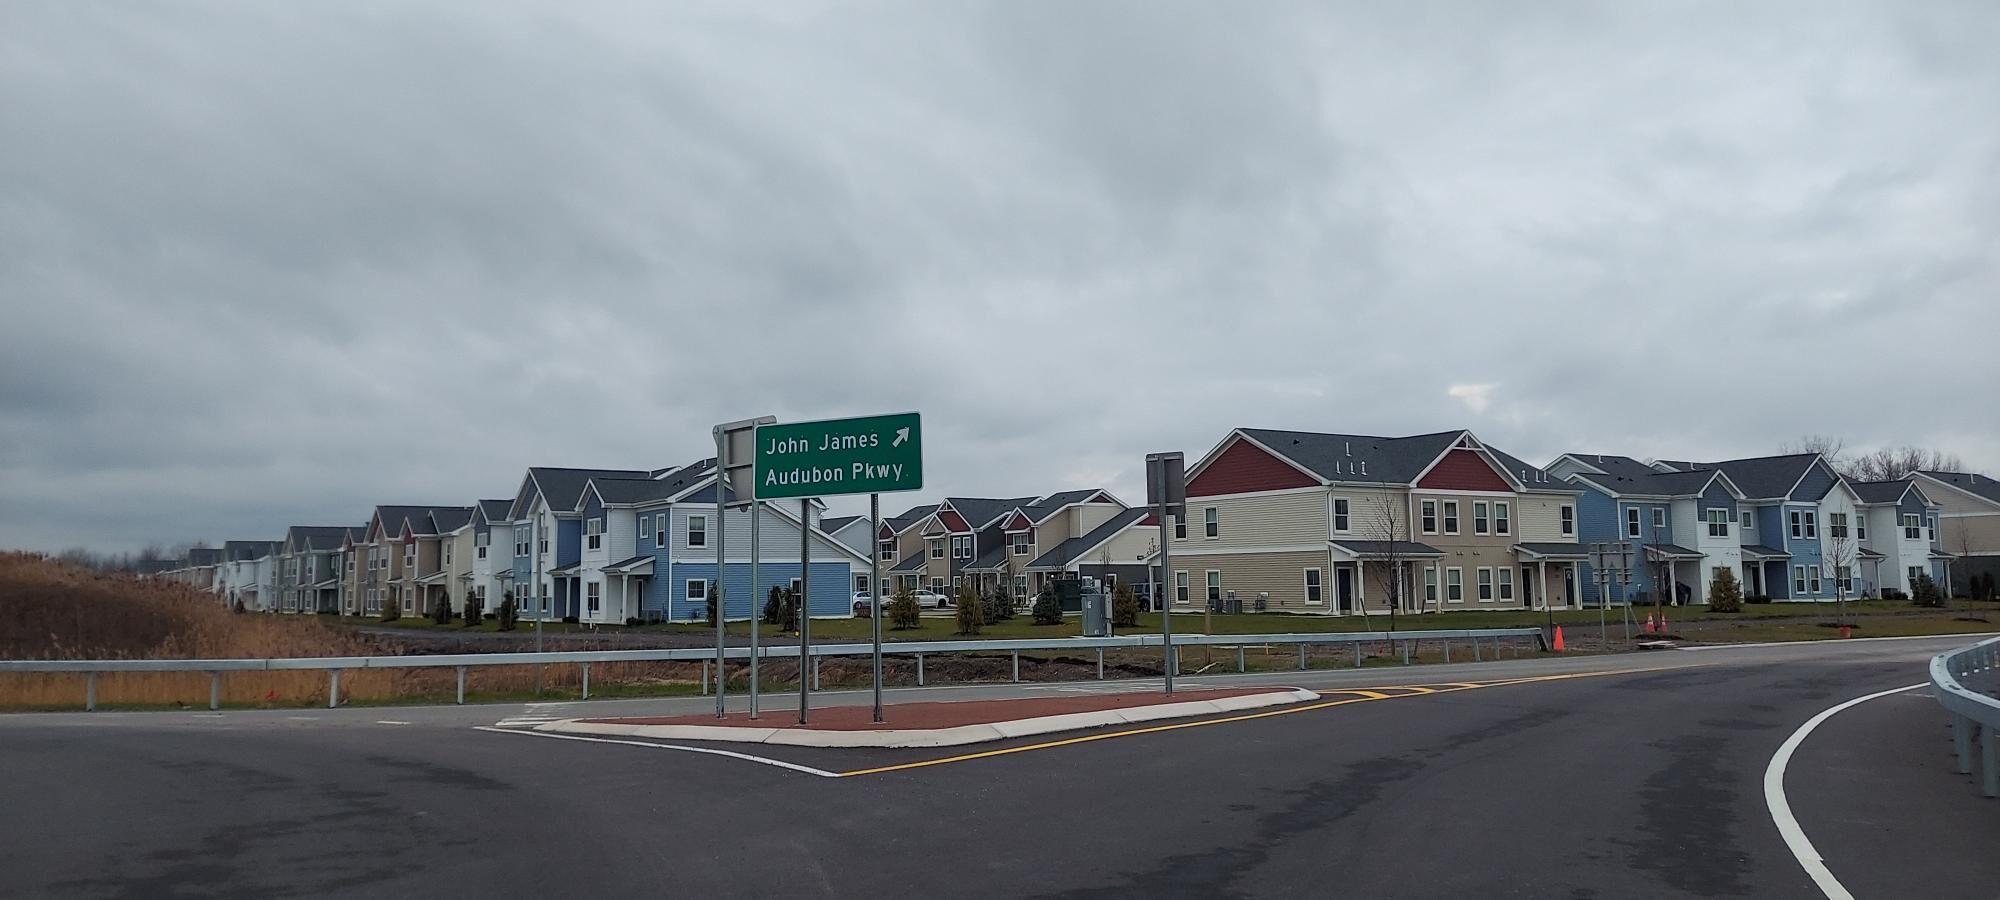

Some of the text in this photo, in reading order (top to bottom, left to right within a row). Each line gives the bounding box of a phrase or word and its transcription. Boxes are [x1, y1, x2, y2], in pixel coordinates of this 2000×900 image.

[766, 433, 879, 455] John James
[765, 462, 903, 486] Audubon Pkwy
